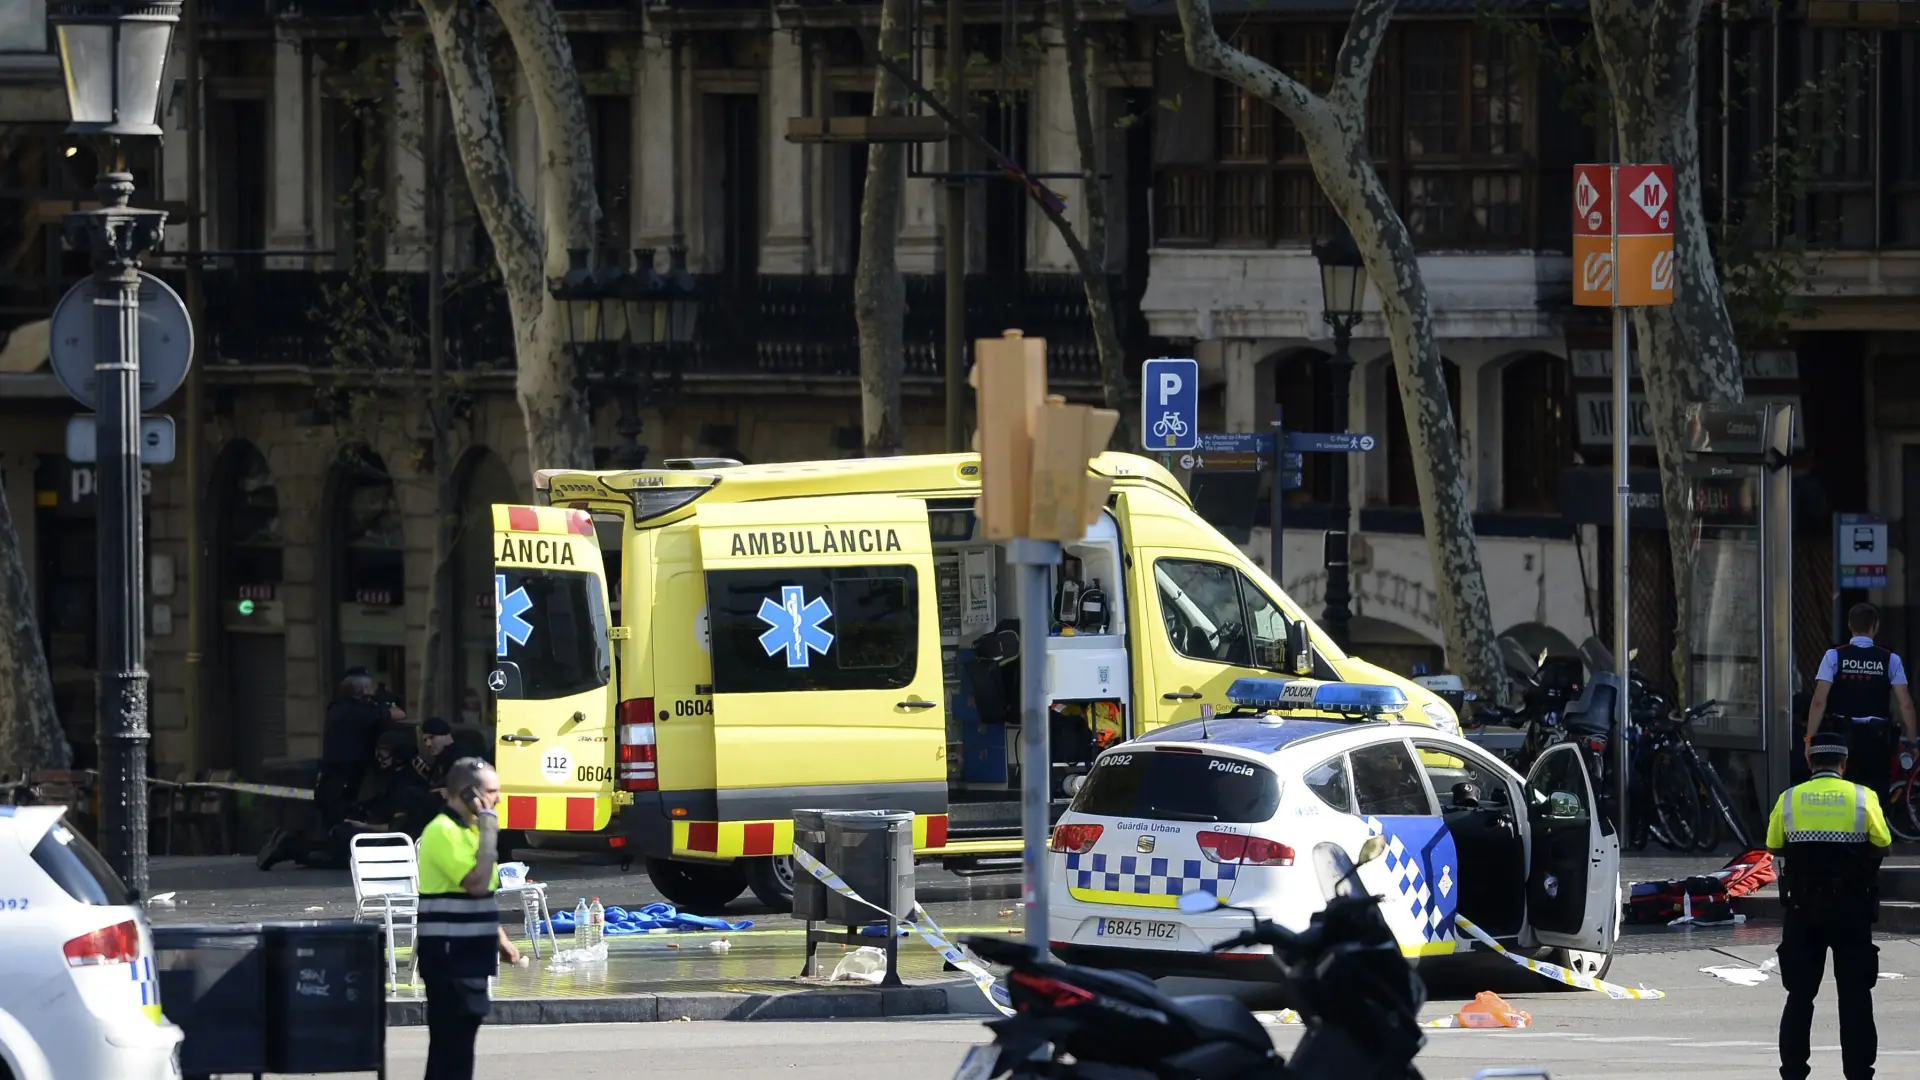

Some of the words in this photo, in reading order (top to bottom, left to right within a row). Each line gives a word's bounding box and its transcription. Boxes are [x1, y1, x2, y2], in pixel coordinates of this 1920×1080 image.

[1579, 185, 1589, 206] M
[1644, 185, 1660, 206] M
[1159, 373, 1182, 406] P
[71, 468, 152, 503] ps
[1629, 492, 1661, 508] OURIST
[731, 525, 902, 557] AMBULÀNCIA
[1842, 659, 1884, 670] POLICIA
[1283, 686, 1314, 698] POLICIA
[675, 699, 714, 717] 0604
[546, 757, 567, 769] 112
[1208, 760, 1255, 777] Policia
[577, 766, 613, 783] 0604
[1150, 823, 1181, 834] Urbana
[1213, 825, 1237, 834] C-711
[1107, 920, 1142, 936] 6845
[1146, 922, 1176, 939] HGZ
